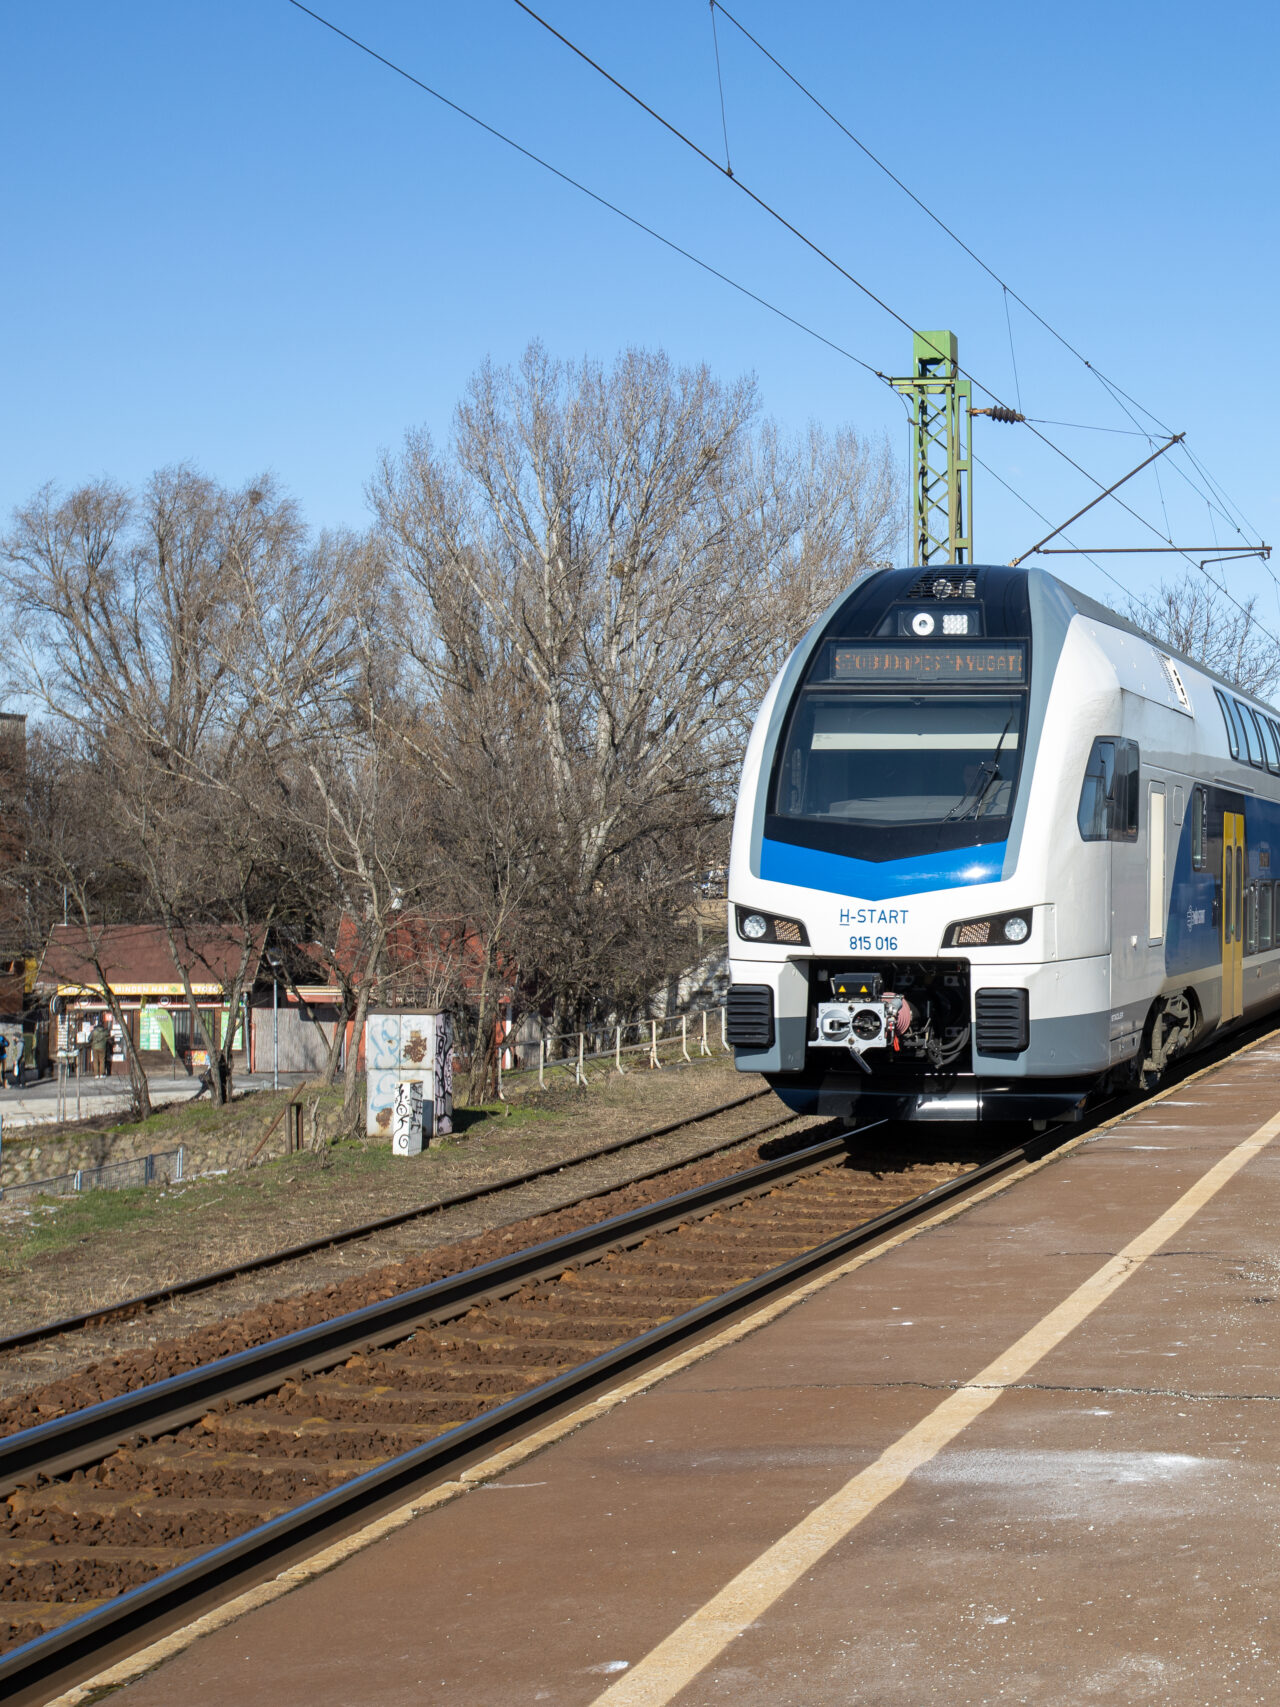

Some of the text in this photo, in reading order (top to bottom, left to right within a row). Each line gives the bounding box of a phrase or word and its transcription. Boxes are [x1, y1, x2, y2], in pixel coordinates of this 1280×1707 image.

[839, 908, 909, 925] H-START
[849, 936, 898, 950] 815 016
[114, 985, 149, 993] MINDEN
[151, 985, 169, 993] NAP
